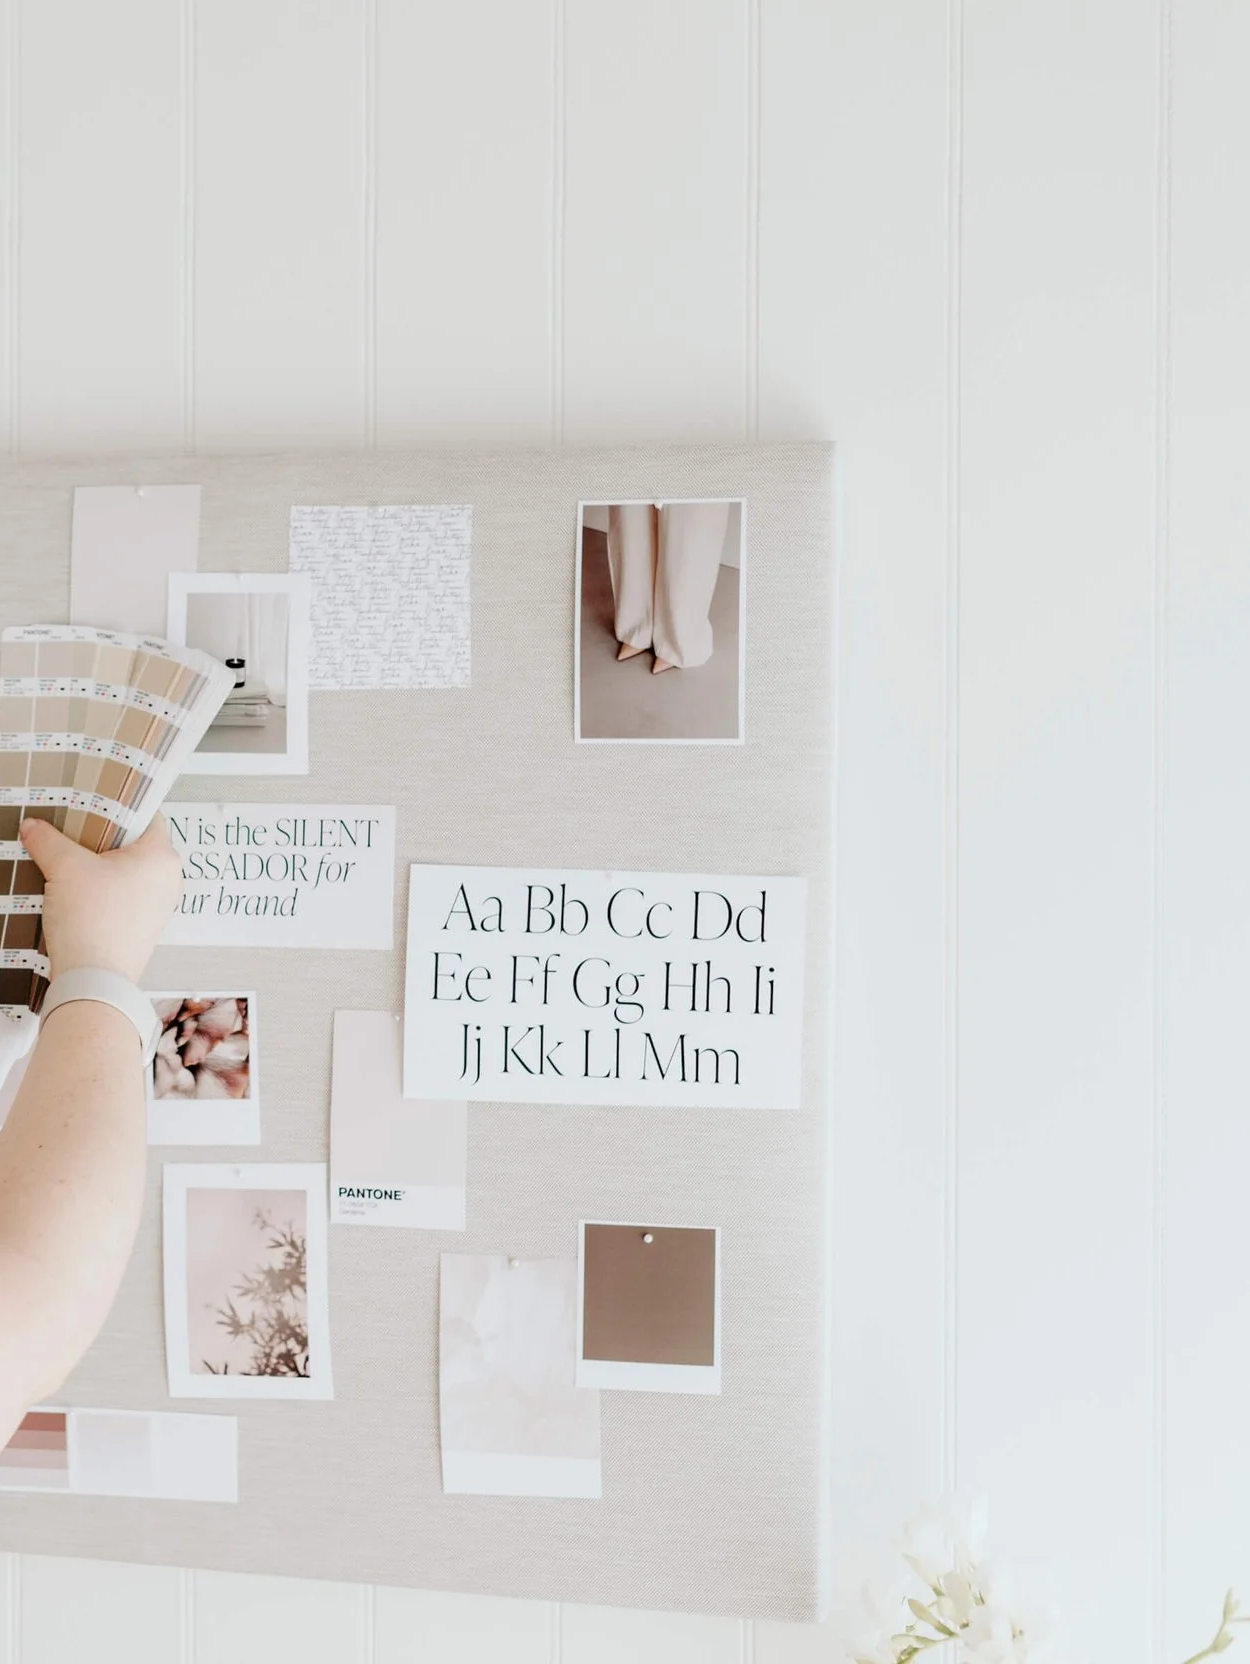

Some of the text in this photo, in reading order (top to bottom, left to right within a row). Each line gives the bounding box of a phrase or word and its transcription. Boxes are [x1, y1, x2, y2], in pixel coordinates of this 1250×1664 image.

[198, 818, 216, 846] is
[225, 816, 268, 847] the
[274, 818, 380, 848] SILENT
[312, 852, 356, 890] for
[217, 885, 299, 917] brand
[441, 882, 767, 943] Aa Bb Cc Dd
[432, 951, 776, 1024] Ee Ff Gg Hh Ii
[459, 1023, 741, 1086] Jj Kk Ll Mm
[338, 1186, 403, 1201] PANTONE
